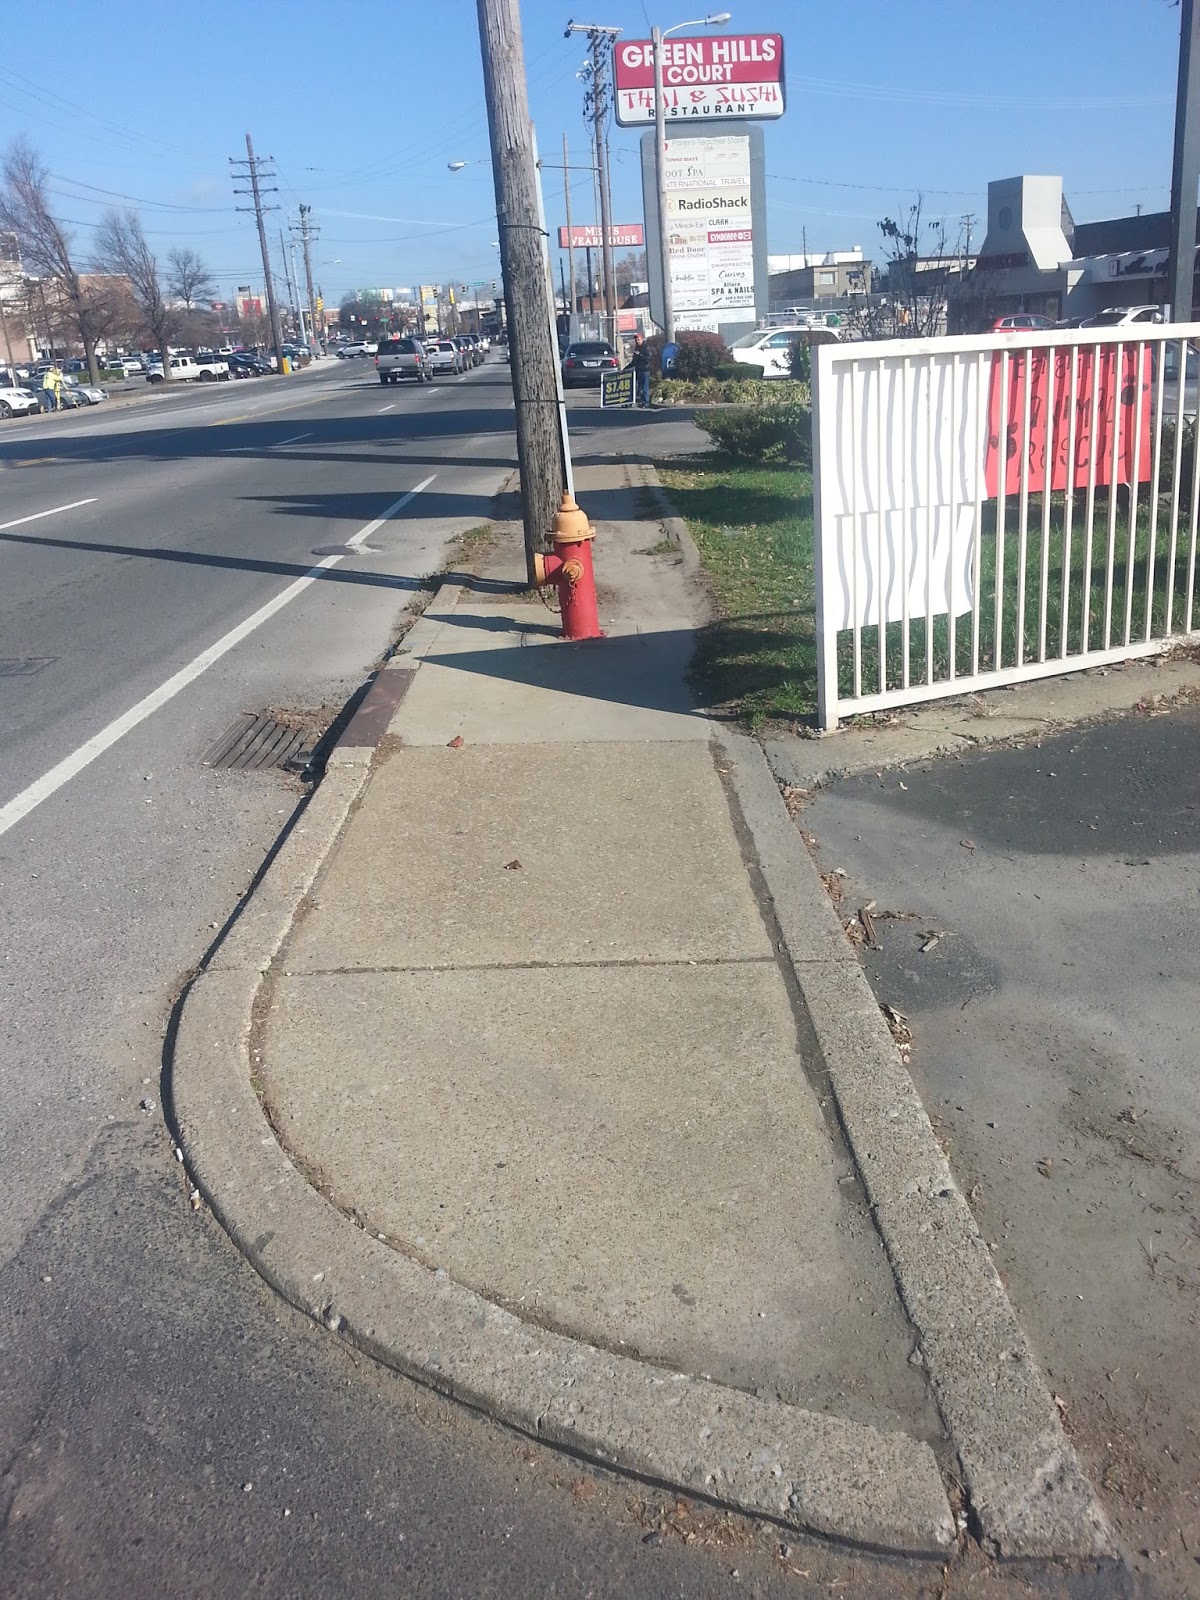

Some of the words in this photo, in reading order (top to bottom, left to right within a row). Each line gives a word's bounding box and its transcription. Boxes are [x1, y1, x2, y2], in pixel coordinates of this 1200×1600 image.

[622, 43, 703, 67] GREEN
[712, 39, 776, 63] HILLS
[667, 64, 733, 83] COURT
[690, 90, 707, 103] &
[716, 85, 778, 104] SUSHI
[665, 170, 683, 178] OOT
[687, 166, 703, 177] SPA
[666, 179, 717, 188] NTERNATIONAL
[678, 196, 748, 210] RadioShack
[585, 227, 619, 236] ME'S
[711, 287, 725, 295] SPA
[734, 286, 754, 294] NAILS
[693, 324, 716, 332] LEASE
